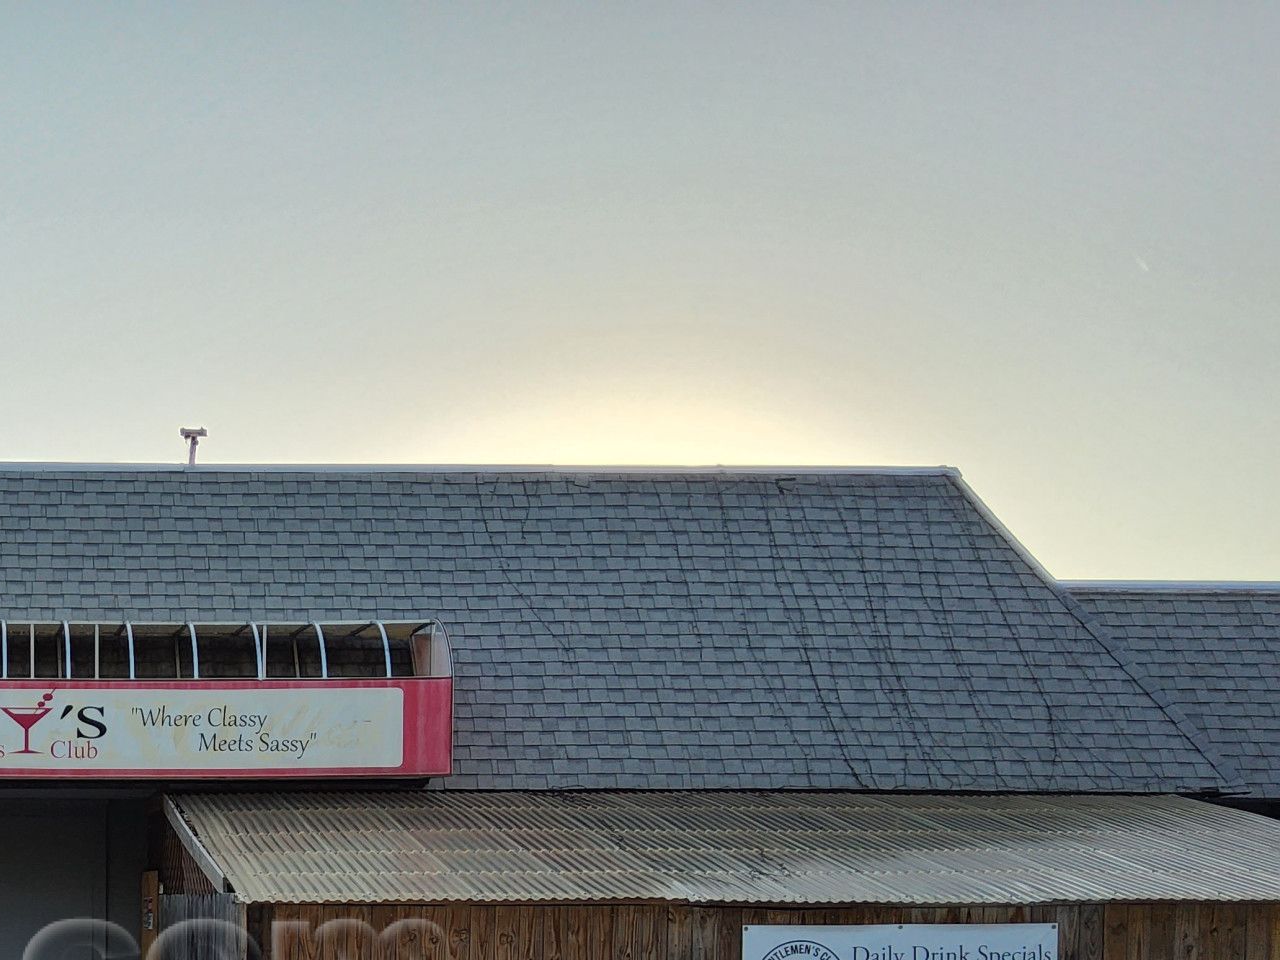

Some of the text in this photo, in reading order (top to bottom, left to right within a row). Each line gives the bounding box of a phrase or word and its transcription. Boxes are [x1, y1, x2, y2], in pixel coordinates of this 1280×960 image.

[131, 705, 268, 735] "Where Classy
[50, 740, 99, 760] Club
[198, 732, 318, 760] Meets Sassy"
